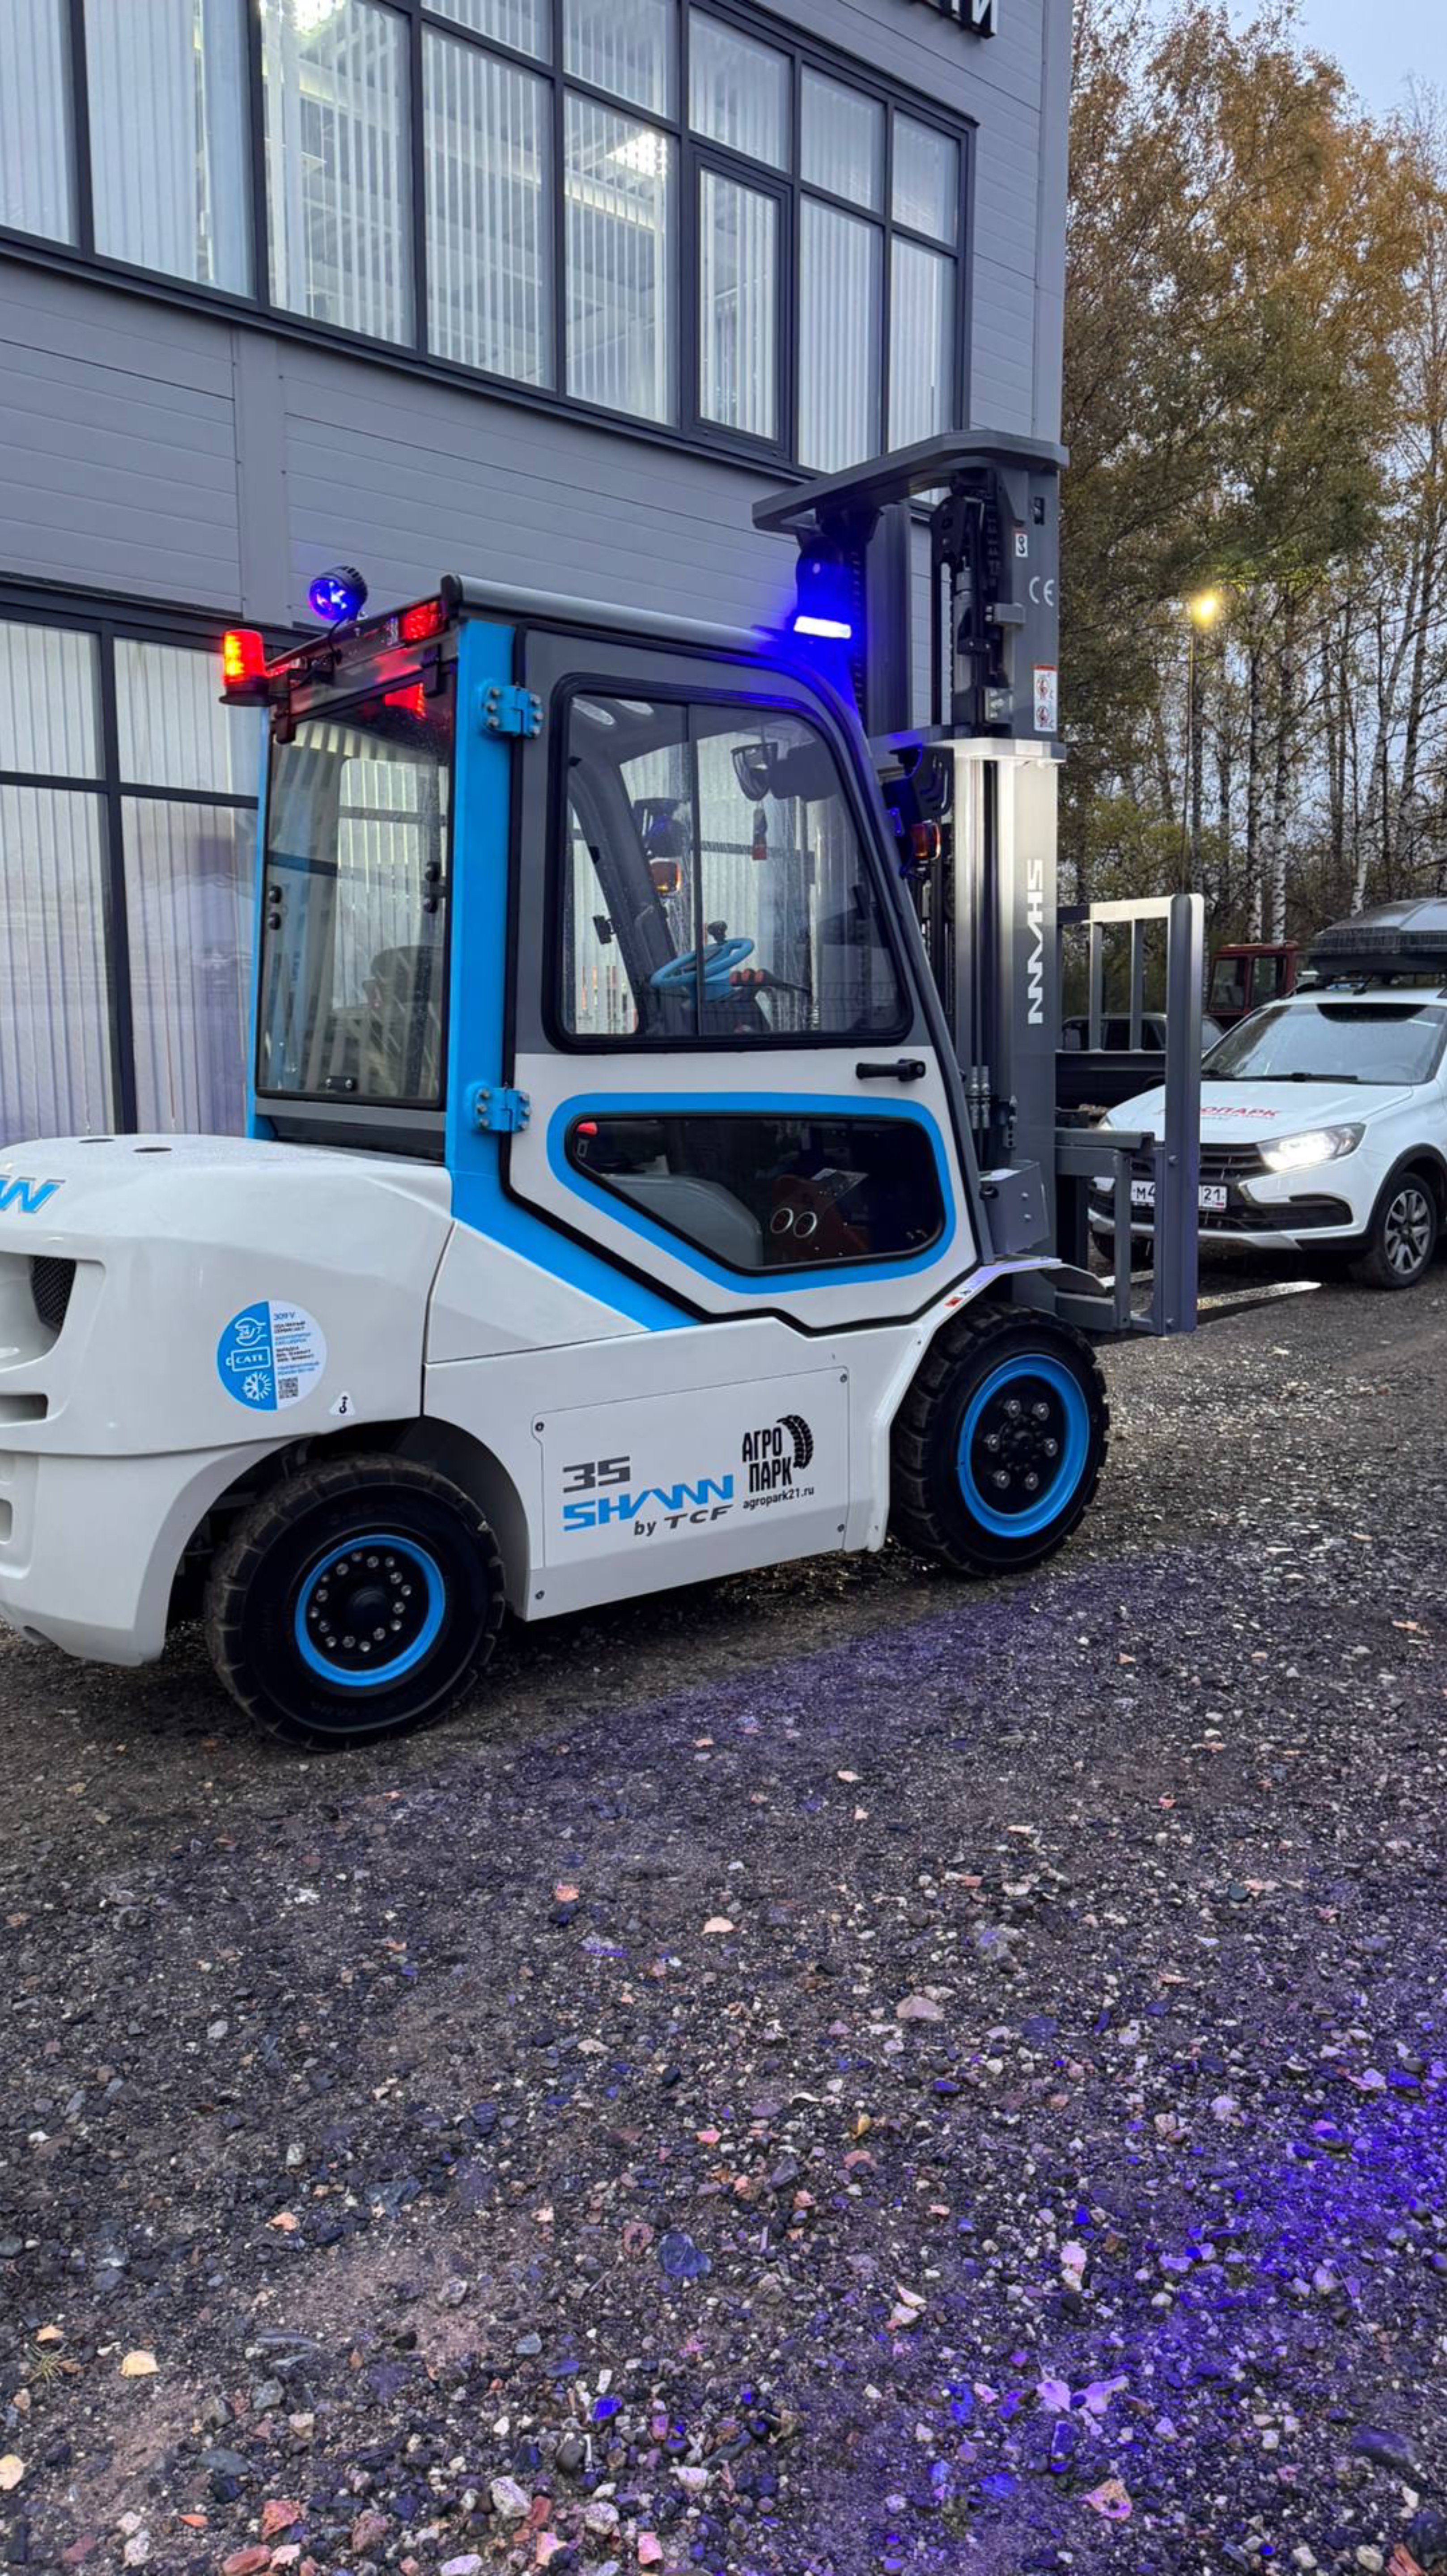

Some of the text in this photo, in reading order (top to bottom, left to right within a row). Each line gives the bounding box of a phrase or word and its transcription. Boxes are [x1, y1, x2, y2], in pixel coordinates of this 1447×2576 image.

[1027, 859, 1044, 1024] SHANN
[236, 1354, 266, 1364] CATL
[742, 1427, 782, 1462] АГРО
[563, 1455, 631, 1493] 35
[749, 1457, 792, 1493] ПАРК
[563, 1474, 734, 1531] SHANN
[743, 1487, 814, 1510] agropark21.ru
[634, 1504, 734, 1537] by TCF
